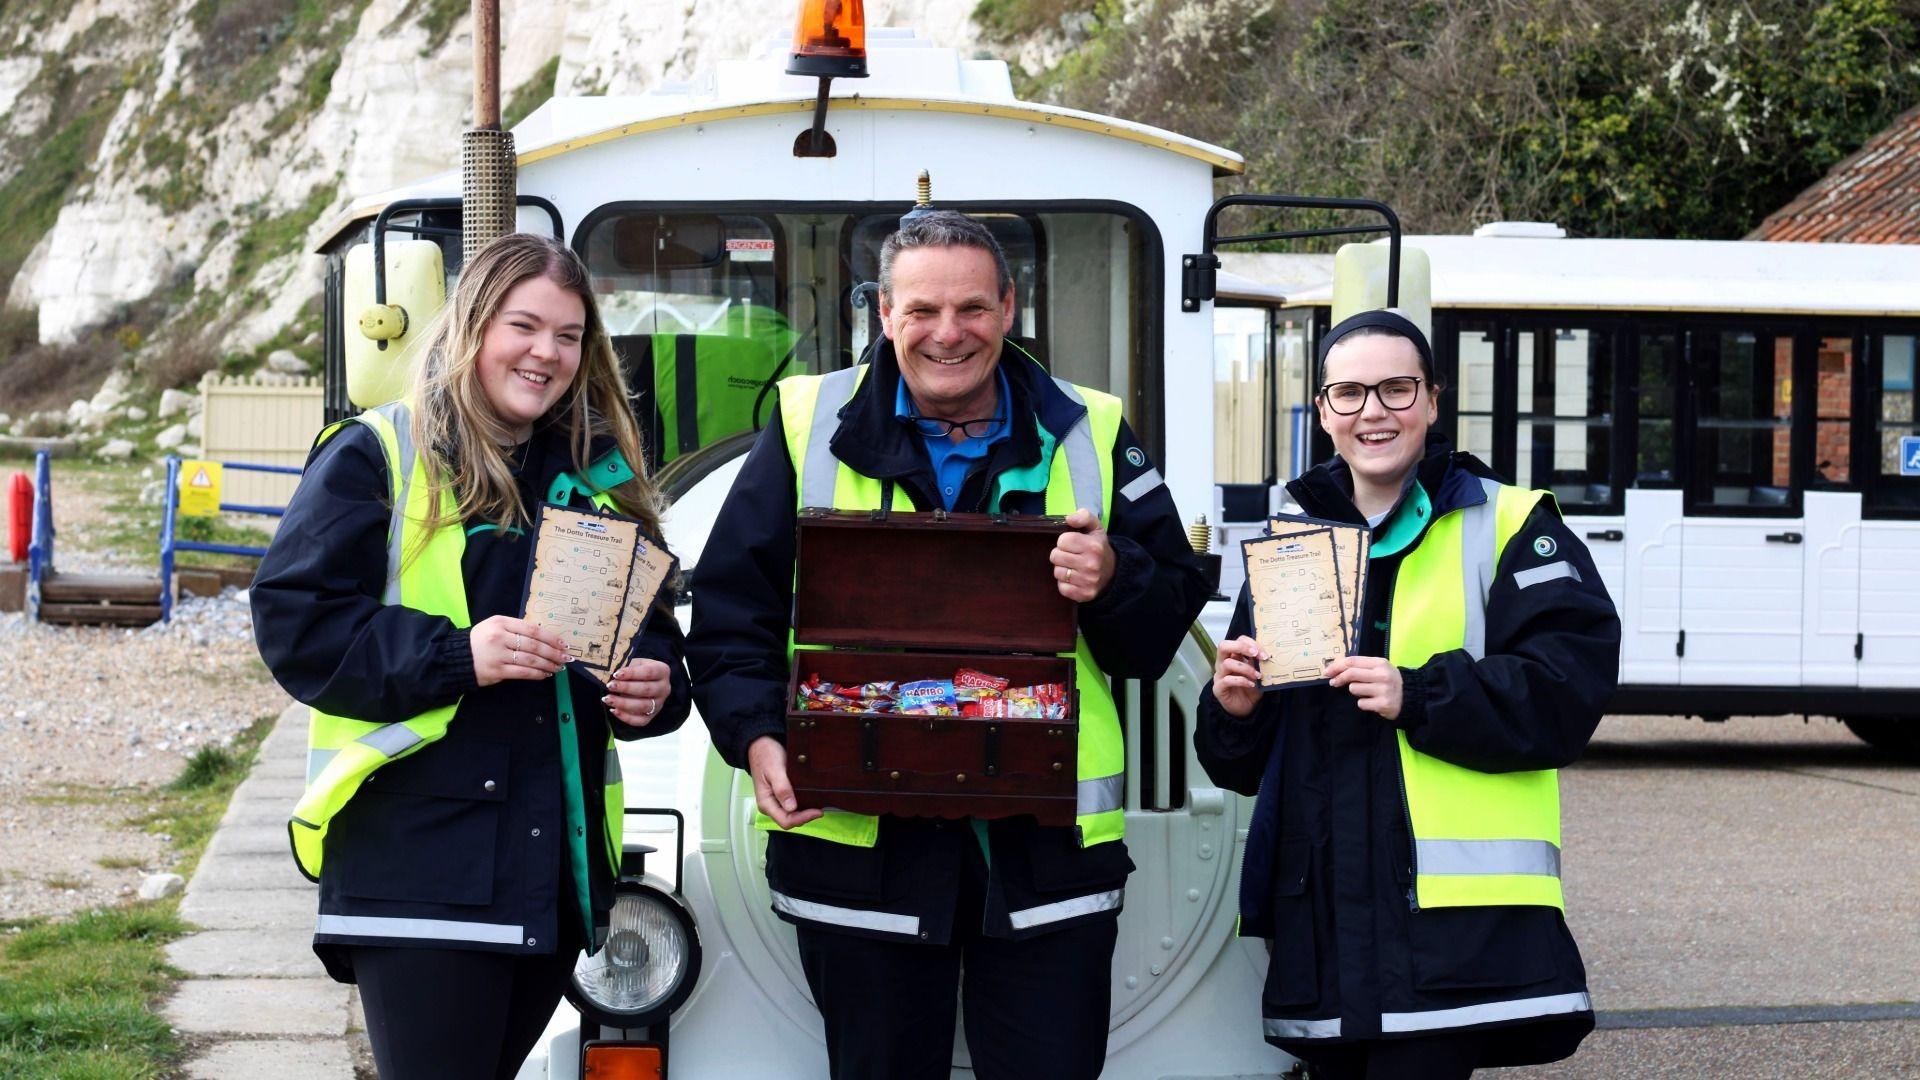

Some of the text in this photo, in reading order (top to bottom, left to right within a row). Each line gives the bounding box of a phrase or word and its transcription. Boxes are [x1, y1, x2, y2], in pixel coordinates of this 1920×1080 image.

[554, 525, 566, 533] The
[585, 531, 610, 541] Treasure
[610, 536, 623, 544] Trail
[645, 560, 657, 571] Trail
[962, 674, 1000, 688] HARIBO
[905, 687, 944, 697] HARIBO
